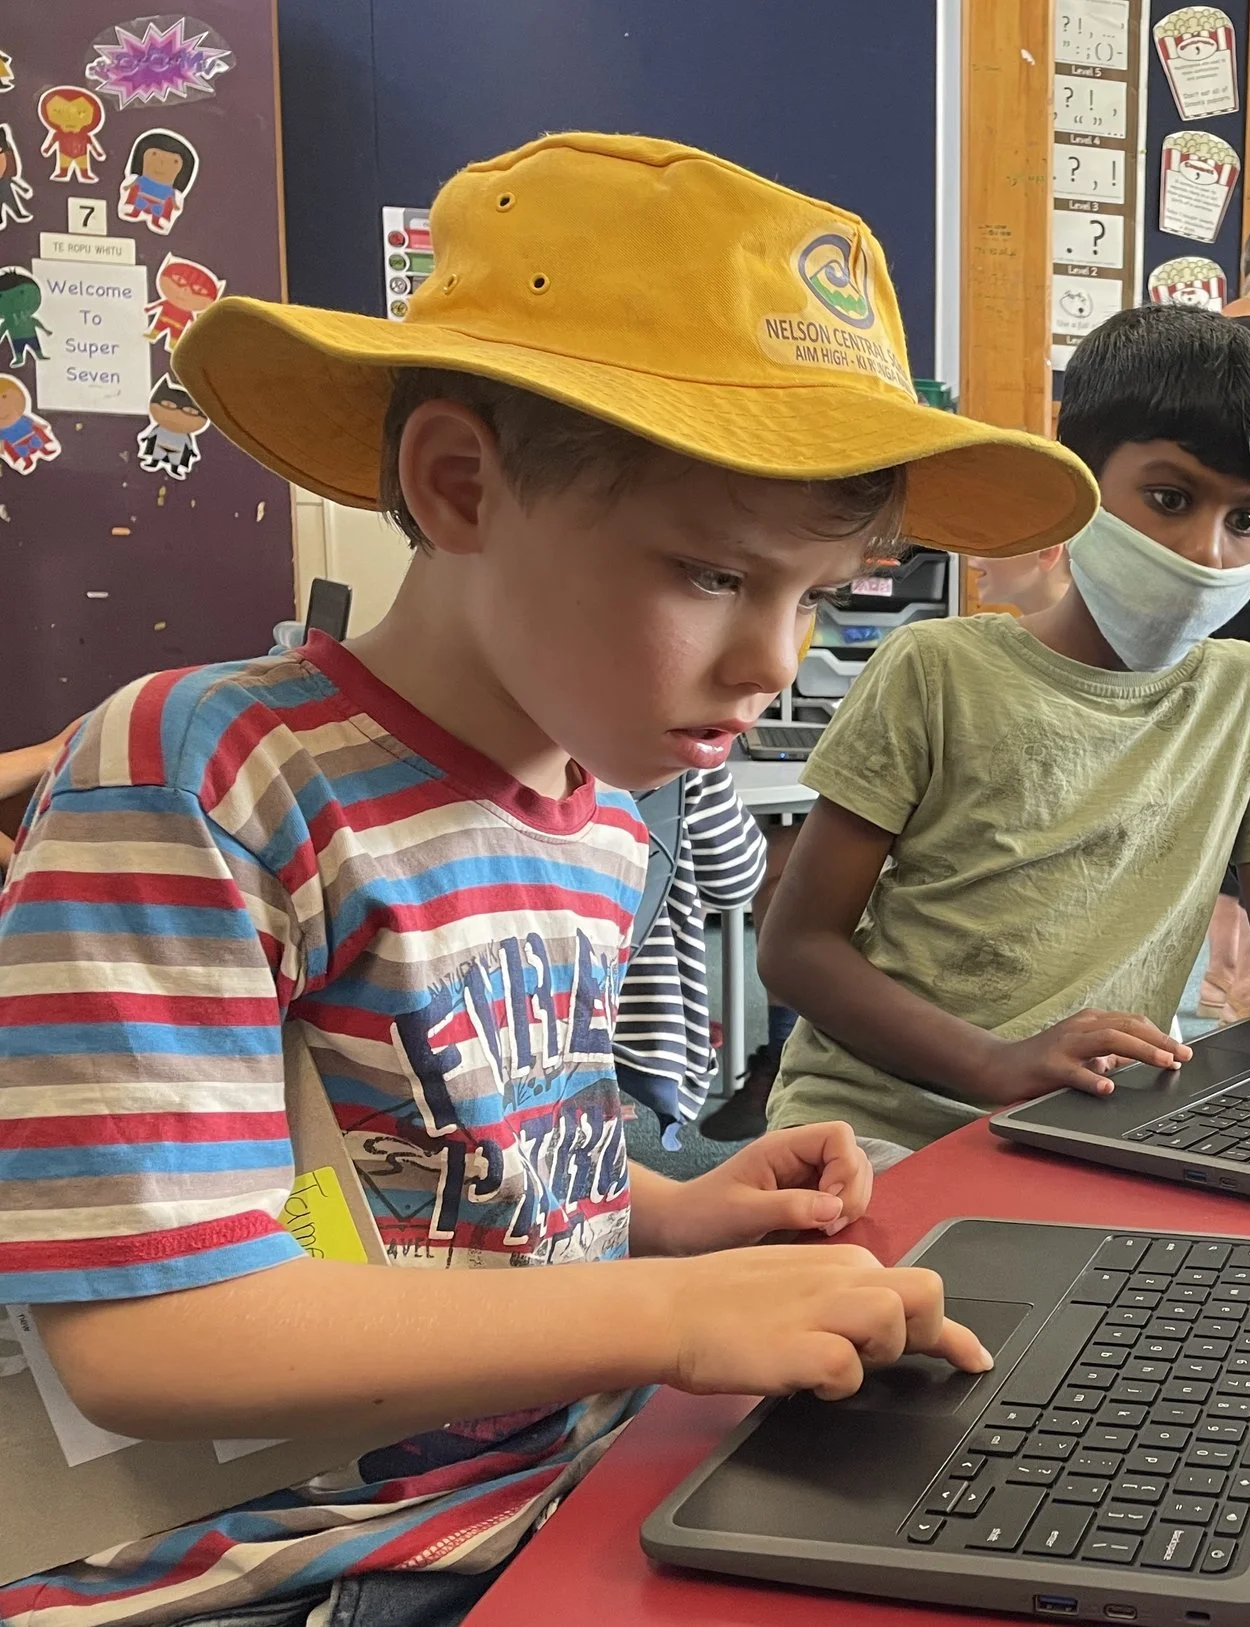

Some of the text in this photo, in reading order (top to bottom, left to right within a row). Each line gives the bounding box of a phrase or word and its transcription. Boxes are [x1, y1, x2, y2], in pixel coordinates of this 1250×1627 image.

[1071, 64, 1102, 77] Level 5
[1070, 134, 1101, 146] Level 4
[1069, 200, 1100, 213] Level 3
[79, 205, 95, 227] 7
[52, 241, 122, 257] TE ROPU WHITU
[1068, 264, 1099, 277] Level 2
[47, 279, 134, 299] Welcome
[79, 309, 103, 326] To
[65, 338, 120, 359] Super
[765, 318, 888, 364] NELSON CENTRAL
[795, 345, 819, 363] AIM
[822, 346, 849, 367] HIGH
[856, 354, 868, 371] KI
[66, 366, 121, 384] Seven
[386, 1235, 435, 1260] AVEL
